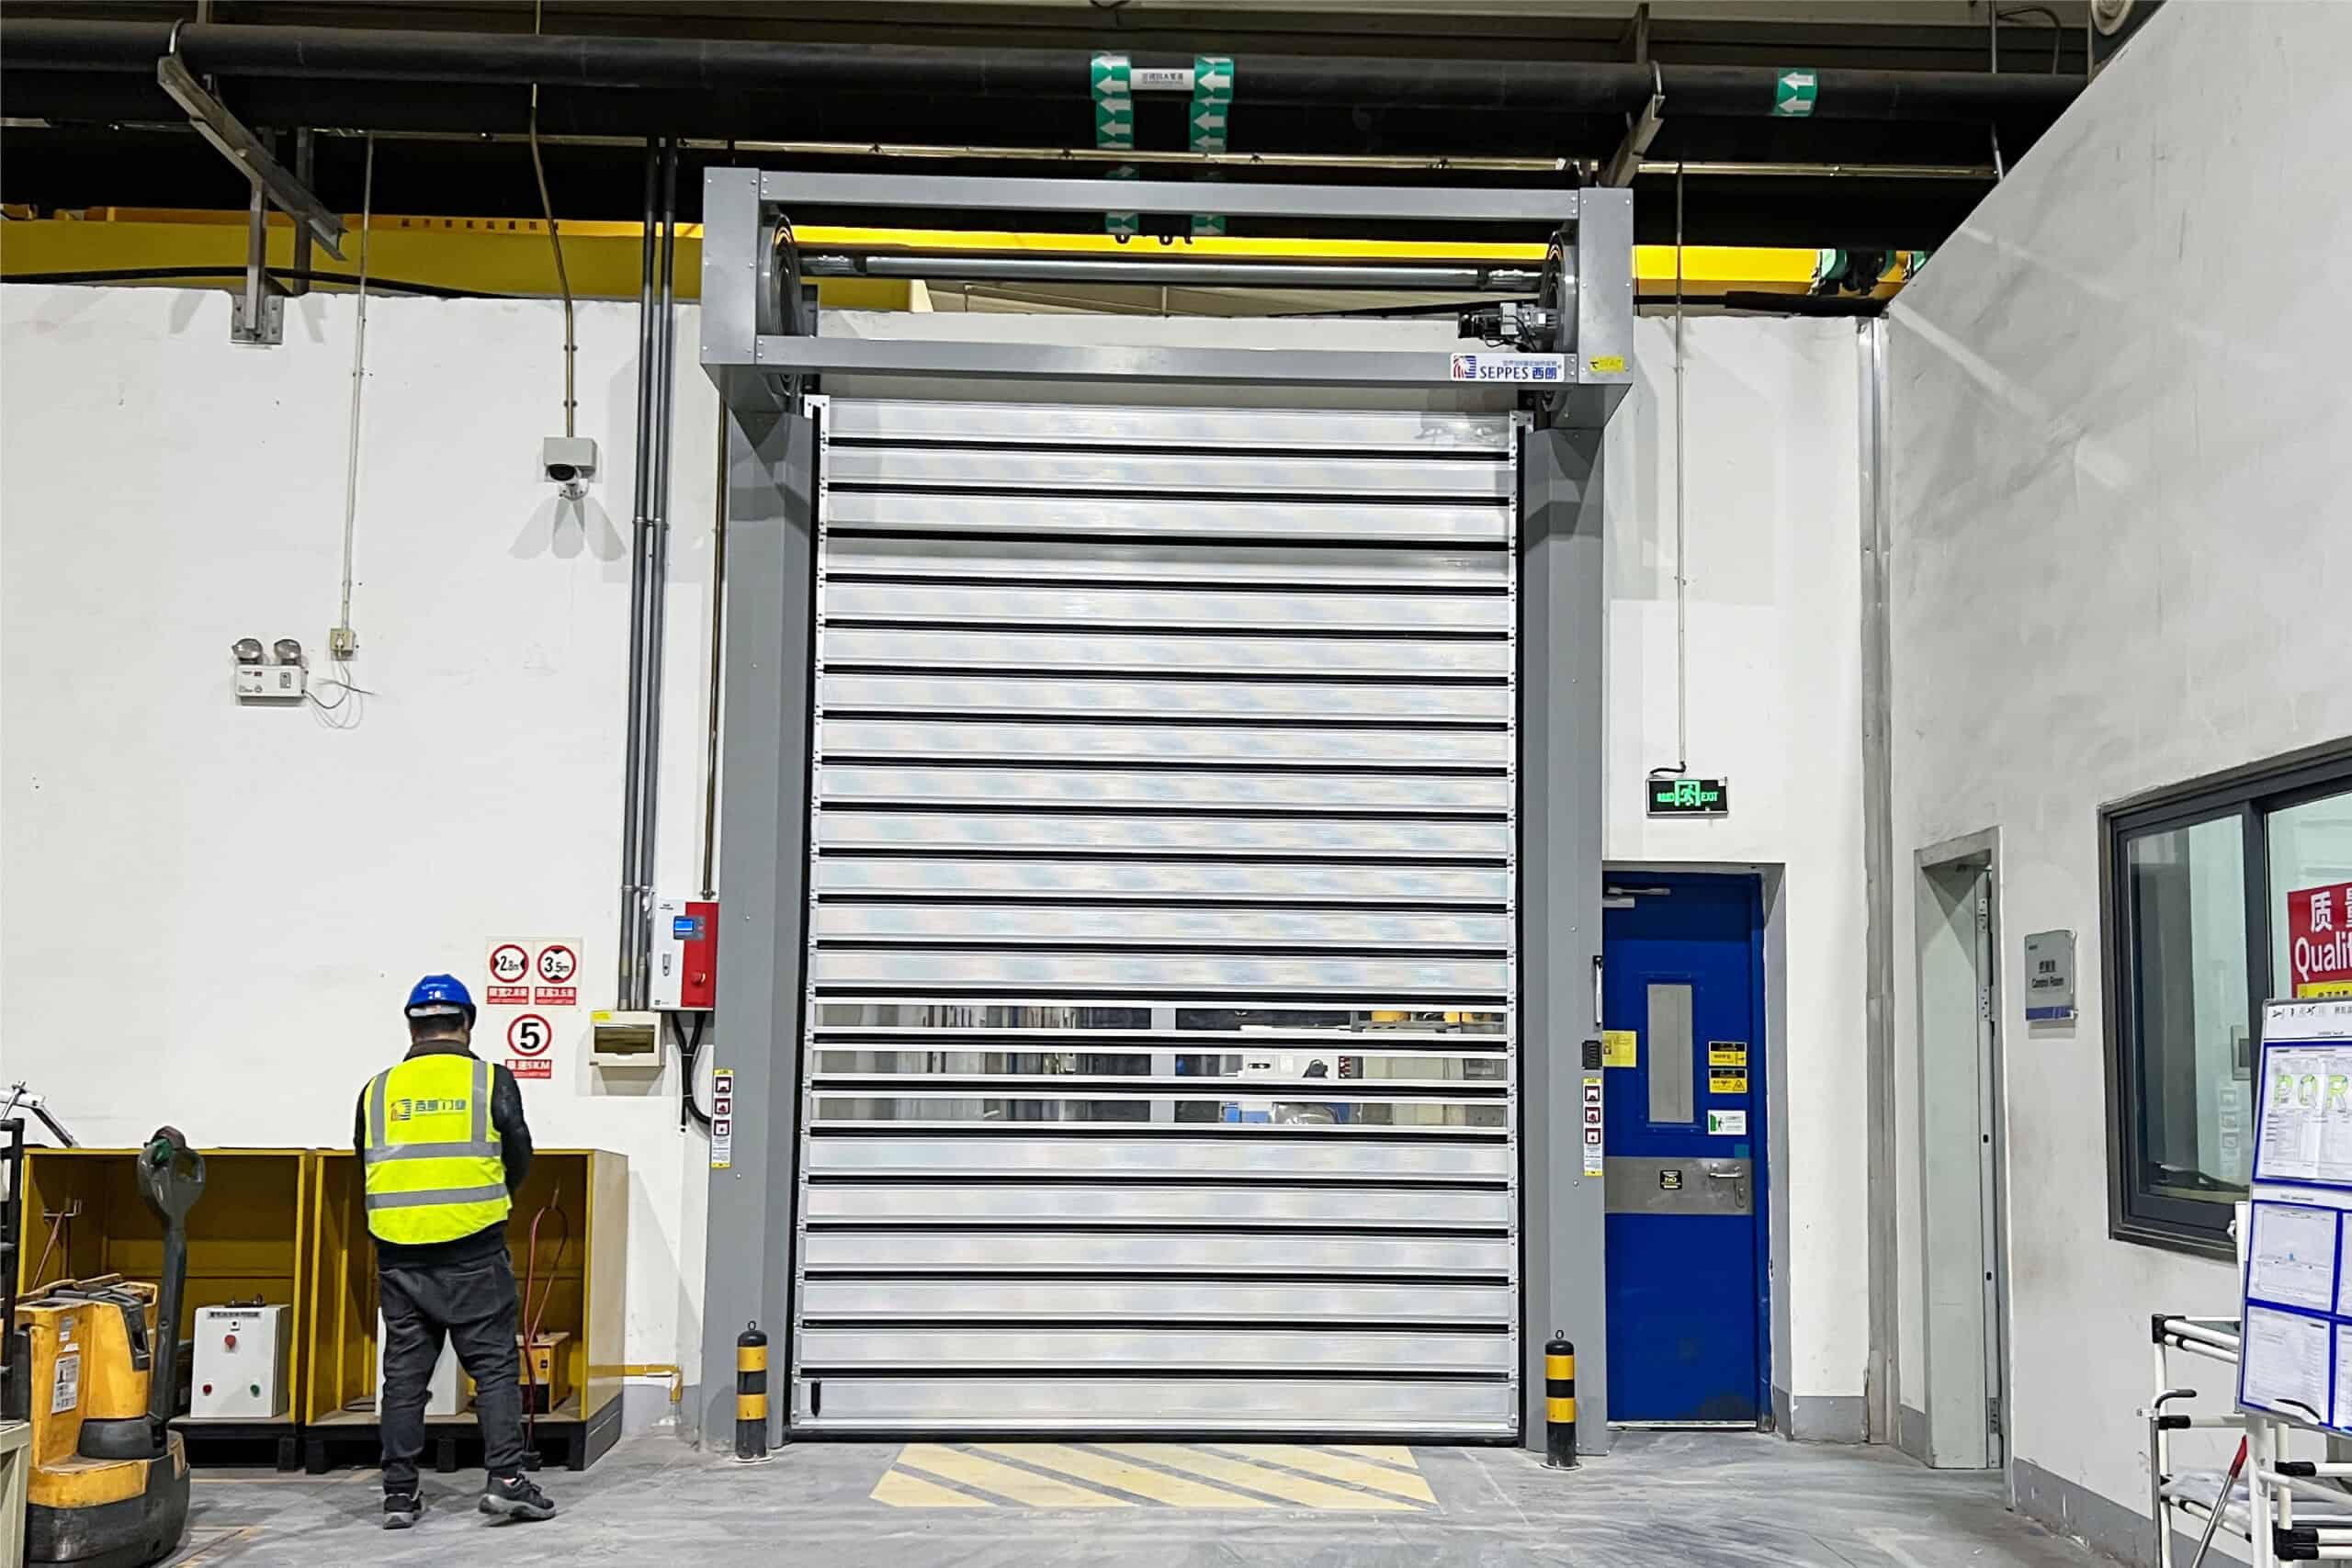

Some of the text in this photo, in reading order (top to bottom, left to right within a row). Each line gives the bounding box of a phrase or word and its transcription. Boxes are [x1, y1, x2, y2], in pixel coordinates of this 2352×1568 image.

[1480, 367, 1557, 379] SEPPES 西朗
[544, 956, 570, 973] 3.5m
[520, 1022, 540, 1050] 5
